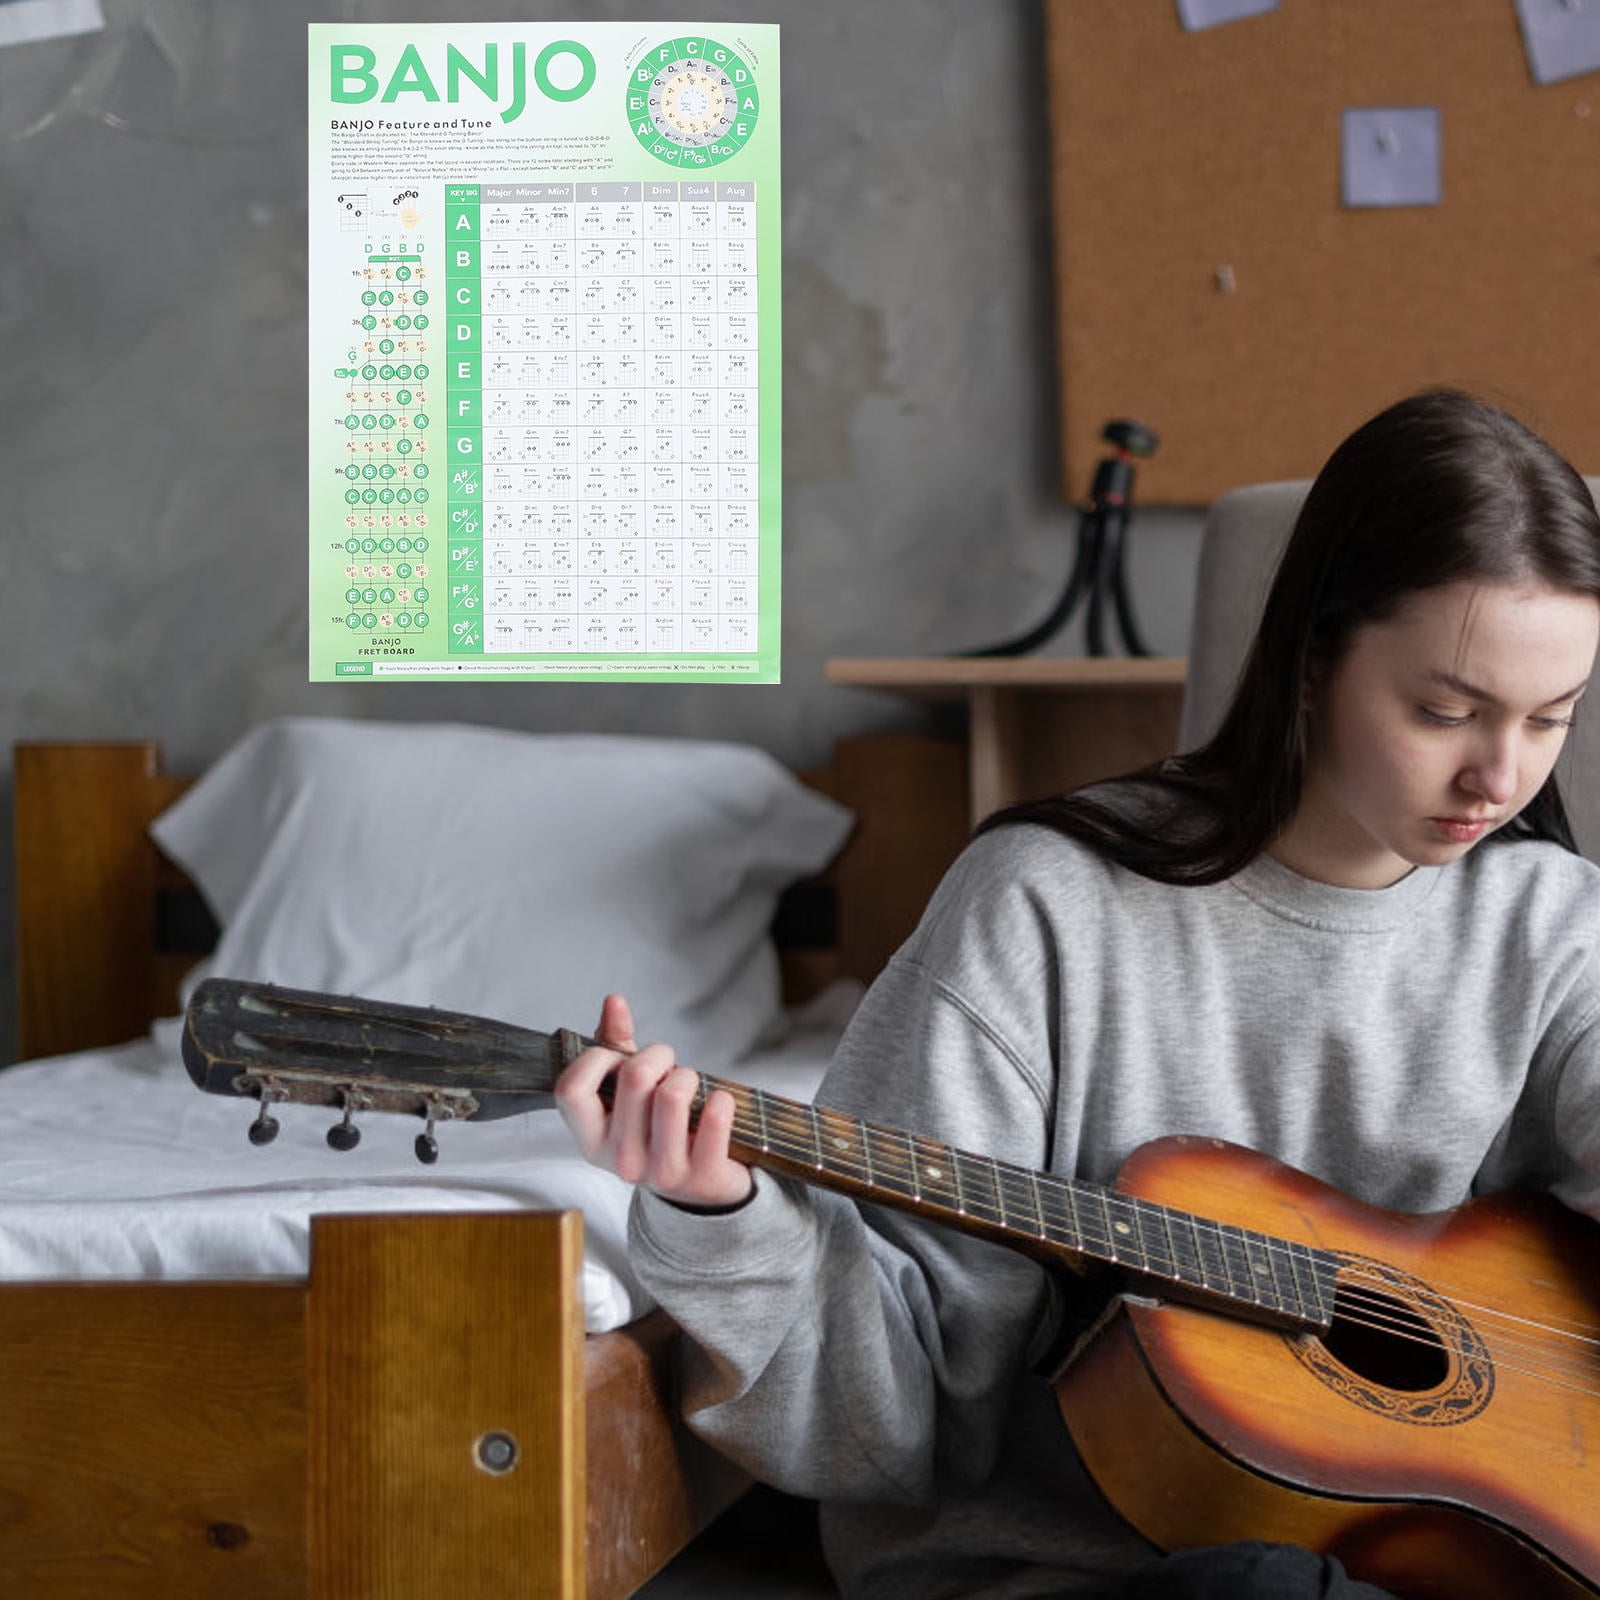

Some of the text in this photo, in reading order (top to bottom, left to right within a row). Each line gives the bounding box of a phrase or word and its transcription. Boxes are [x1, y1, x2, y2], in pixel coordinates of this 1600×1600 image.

[660, 50, 669, 61] F
[687, 42, 697, 54] C
[714, 50, 726, 62] G
[331, 40, 596, 123] BANJO
[736, 70, 746, 81] D
[743, 98, 754, 109] A
[331, 119, 491, 132] BANJO Feature and Tune
[737, 124, 747, 135] E
[488, 189, 512, 198] Major
[592, 187, 598, 196] 6
[623, 186, 629, 195] 7
[688, 186, 710, 194] Sus4
[726, 187, 745, 196] Aug
[456, 215, 471, 230] A
[365, 244, 424, 253] D G B D
[457, 251, 470, 266] B
[457, 288, 470, 304] C
[458, 325, 471, 340] D
[348, 351, 357, 360] G
[458, 363, 471, 378] E
[459, 401, 470, 416] F
[457, 437, 472, 453] G
